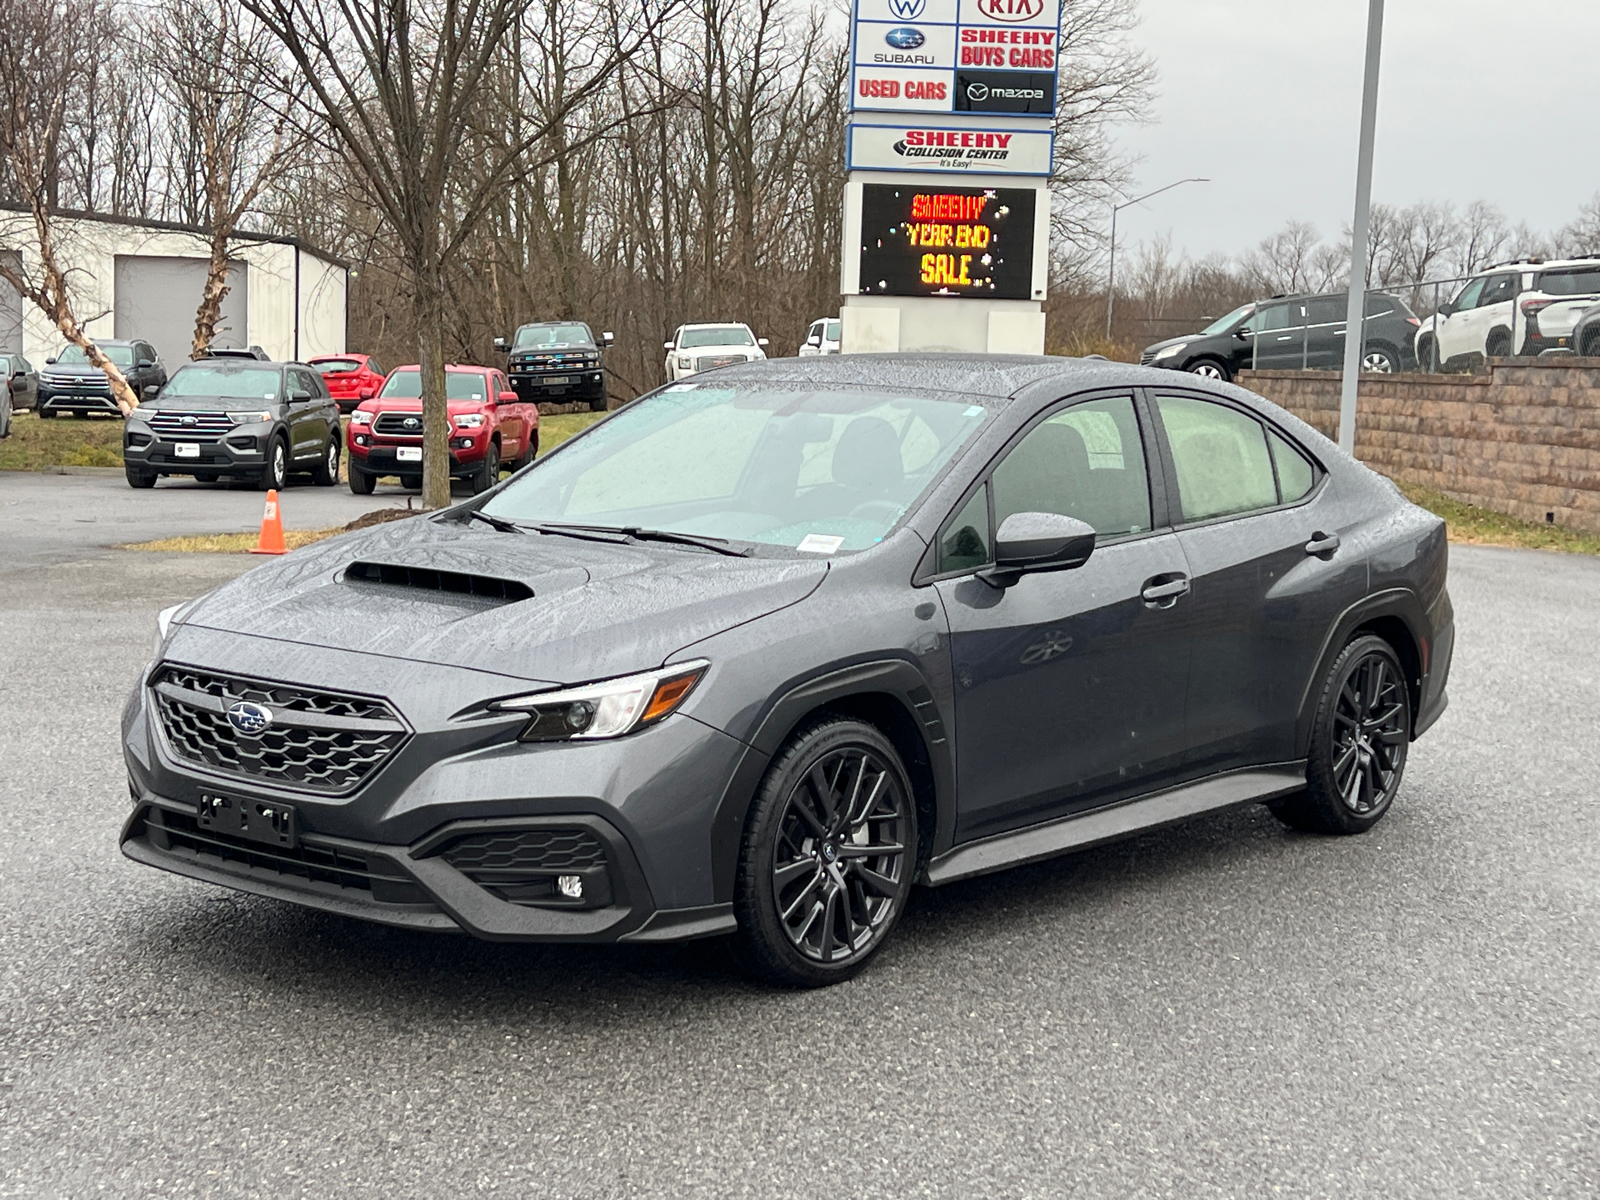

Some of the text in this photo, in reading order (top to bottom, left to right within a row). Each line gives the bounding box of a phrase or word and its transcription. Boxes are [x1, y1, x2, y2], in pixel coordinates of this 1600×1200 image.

[989, 0, 1032, 14] KIA
[961, 29, 1055, 45] SHEEHY
[874, 53, 934, 64] SUBARU
[961, 46, 1054, 68] BUYS CARS
[859, 79, 947, 100] USED CARS
[906, 130, 1012, 148] SHEEHY
[905, 147, 1009, 159] COLLISION CENTER
[939, 159, 972, 169] It's Easy!
[907, 223, 990, 248] YEAR END
[921, 253, 972, 285] SALE
